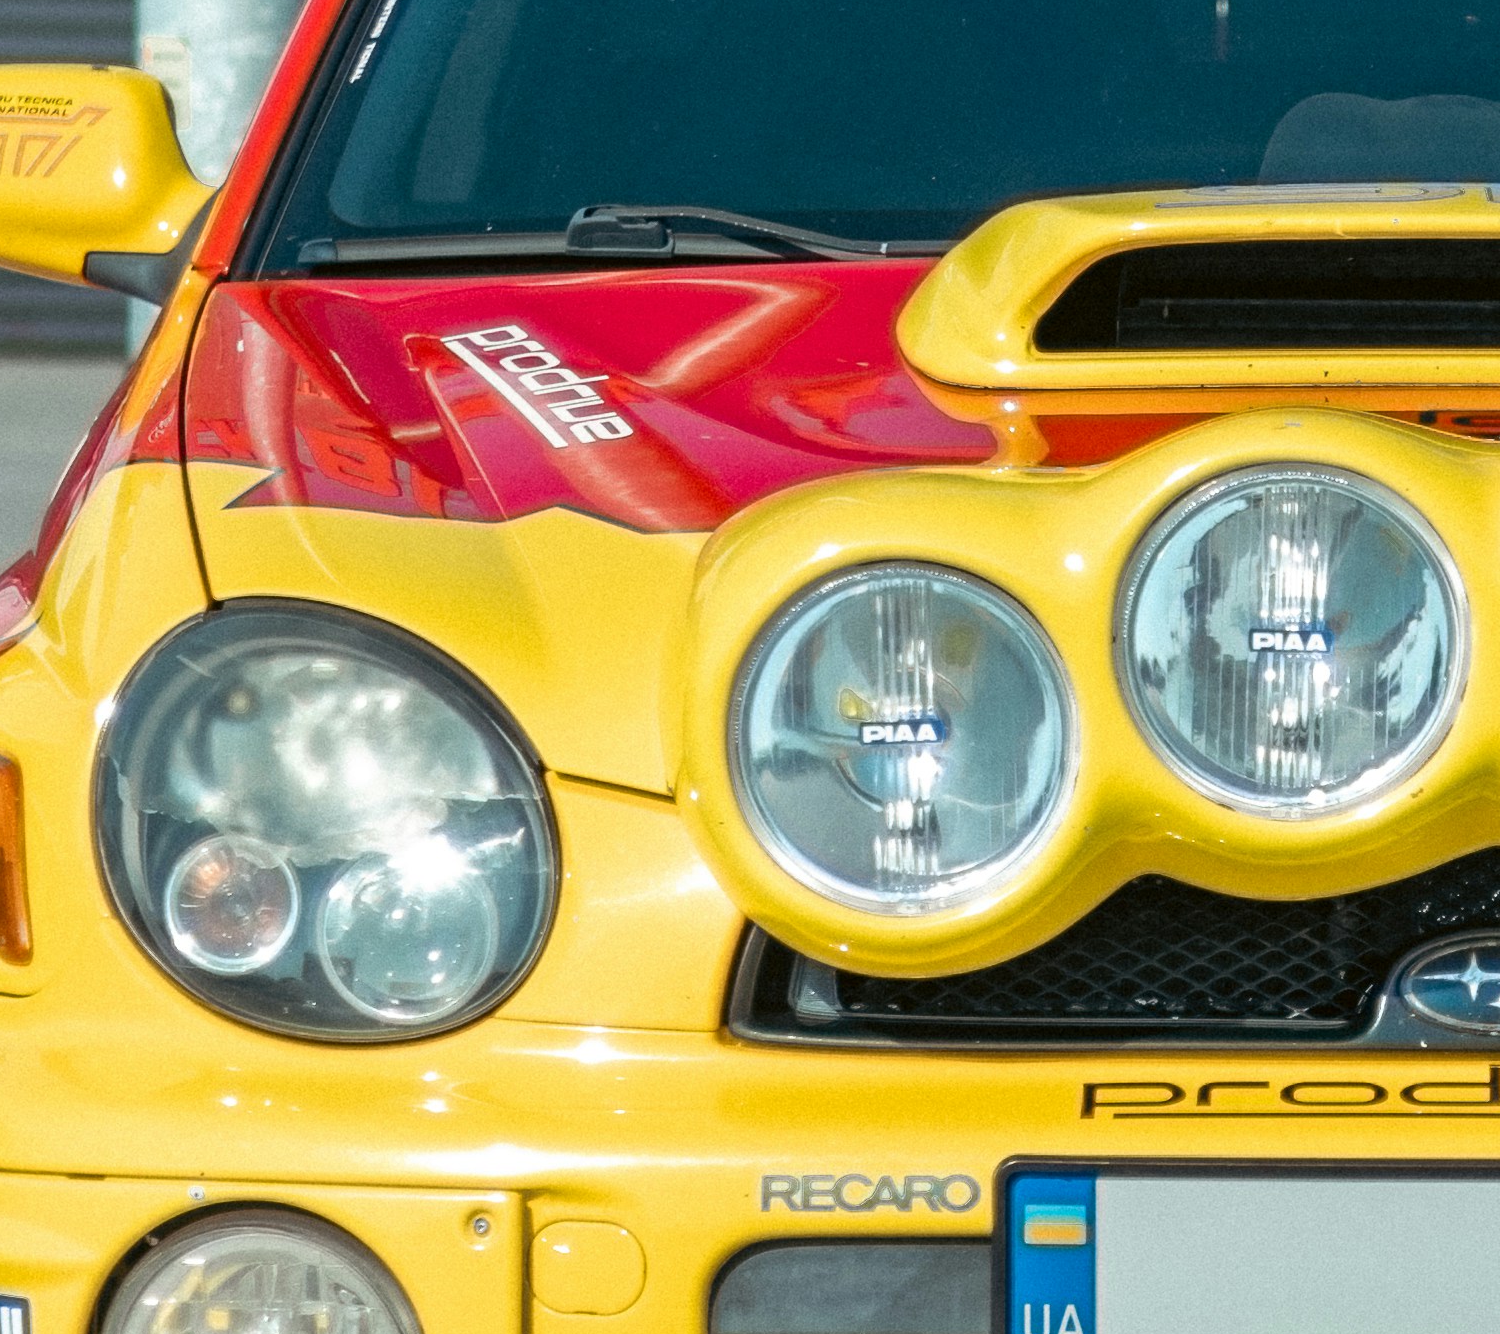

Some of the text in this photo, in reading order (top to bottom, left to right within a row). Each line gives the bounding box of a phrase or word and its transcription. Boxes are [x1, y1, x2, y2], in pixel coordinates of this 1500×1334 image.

[16, 95, 74, 106] TECNICA
[440, 325, 634, 444] prodrive
[1252, 632, 1328, 651] PIAA
[862, 723, 938, 744] PIAA
[760, 1174, 982, 1213] RECARO
